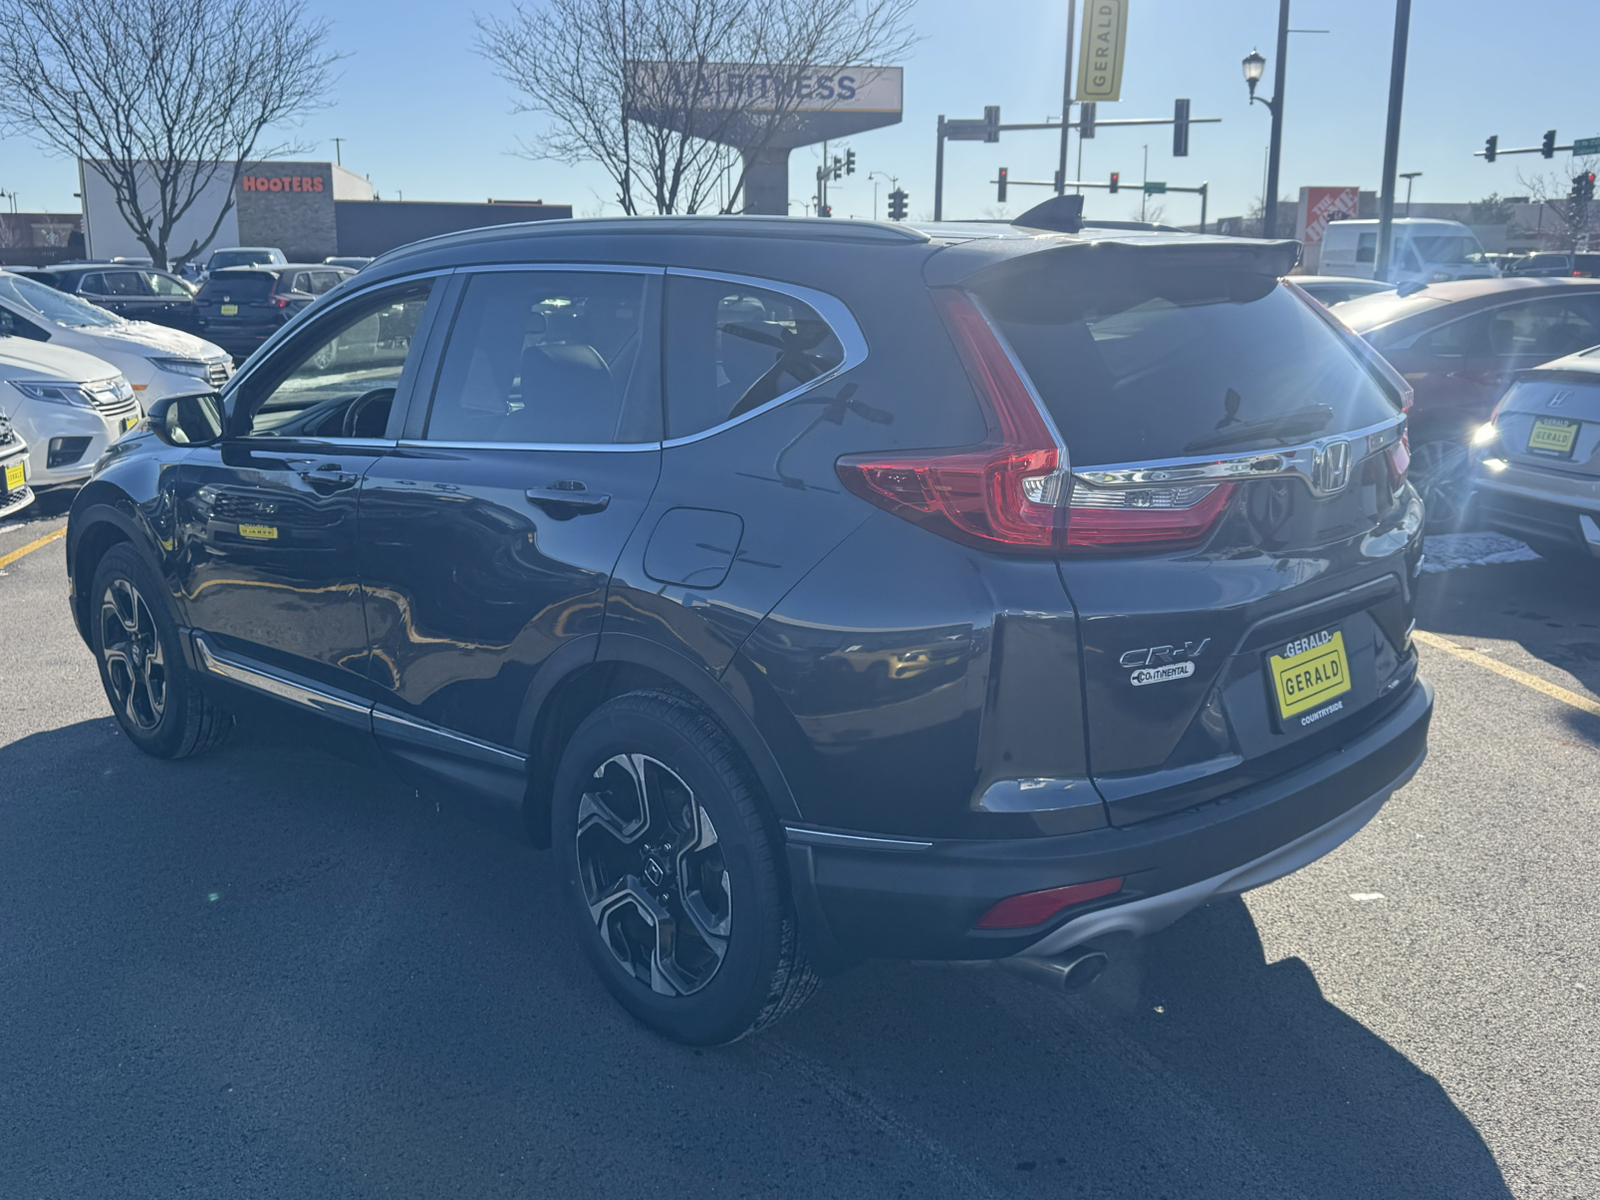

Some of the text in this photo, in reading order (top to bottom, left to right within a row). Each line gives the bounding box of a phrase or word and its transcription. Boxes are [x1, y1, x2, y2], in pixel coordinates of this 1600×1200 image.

[1092, 5, 1113, 88] GERALD
[242, 176, 324, 193] HOOTERS
[1536, 430, 1568, 444] GERALD
[1120, 637, 1211, 668] CR-V
[1285, 660, 1339, 696] GERALD
[1301, 701, 1344, 726] COUNTRYSIDE
